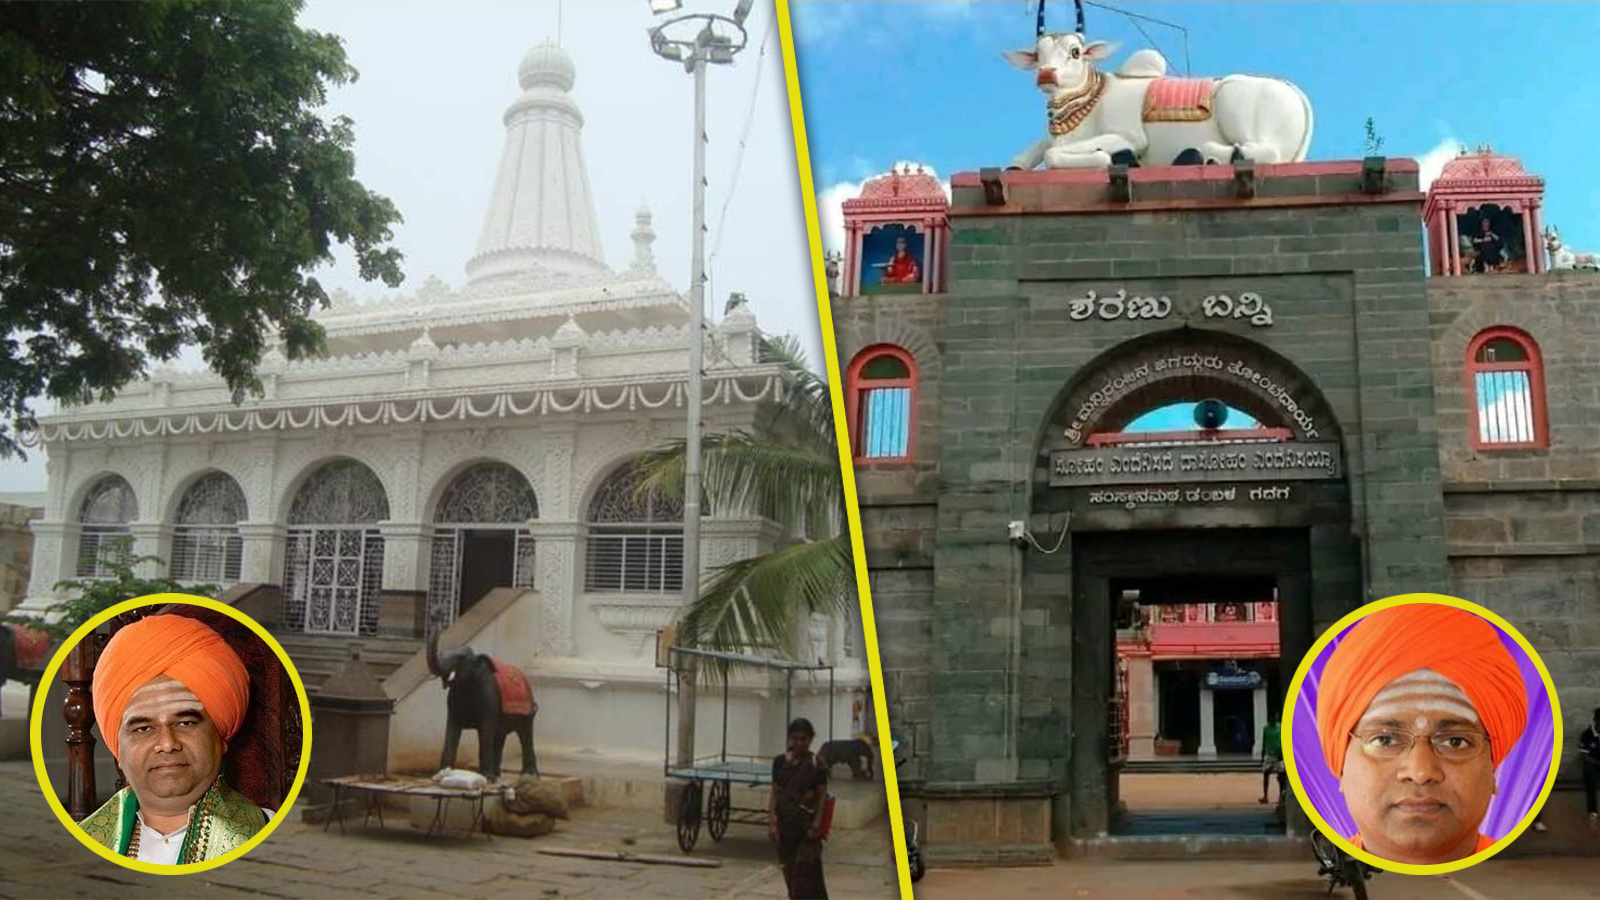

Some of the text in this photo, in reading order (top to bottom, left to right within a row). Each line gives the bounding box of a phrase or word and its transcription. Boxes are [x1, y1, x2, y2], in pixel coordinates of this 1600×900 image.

[1068, 288, 1274, 326] ಶರಣು ಬನ್ನಿ
[1064, 420, 1082, 444] ಶ್ರೀ
[1154, 352, 1223, 373] ಜಗದ್ಗುರು
[1180, 450, 1247, 471] ದಾಸೋಹಂ
[1186, 486, 1236, 502] ಡಂಬಳ
[1249, 486, 1290, 500] ಗದಗ
